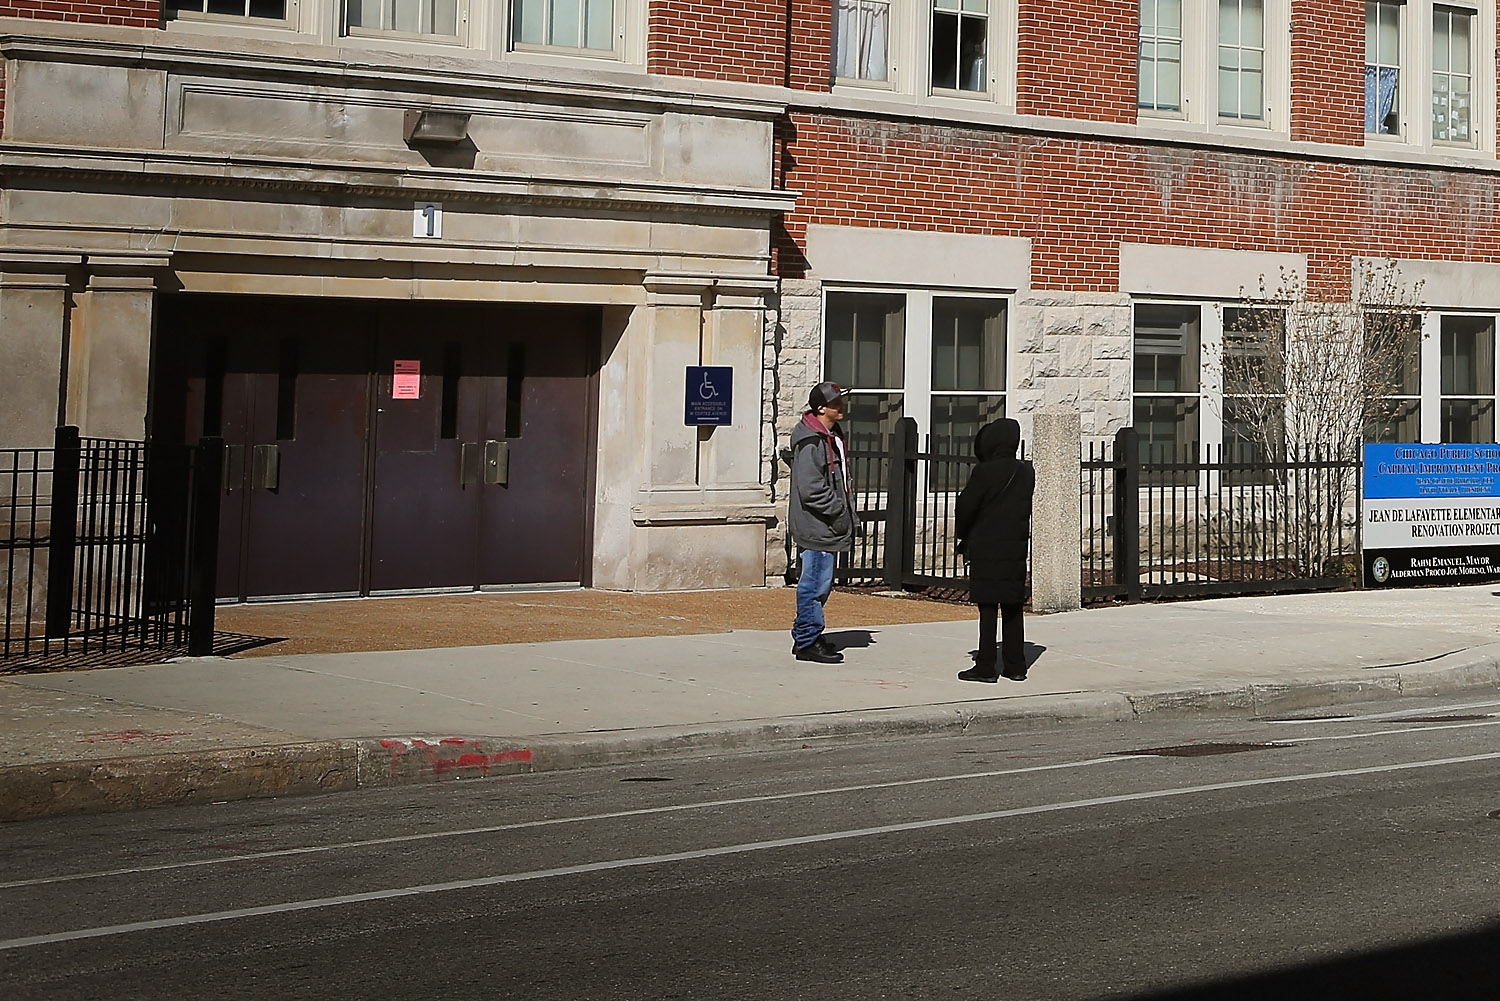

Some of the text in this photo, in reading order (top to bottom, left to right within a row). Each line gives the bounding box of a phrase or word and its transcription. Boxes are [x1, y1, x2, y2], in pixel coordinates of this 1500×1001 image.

[422, 206, 435, 237] 1
[1395, 448, 1437, 460] CHICAGO
[1440, 447, 1472, 459] PUBLIC
[1378, 463, 1418, 474] CAPITAL
[1419, 462, 1485, 474] IMPROVEMENT
[1369, 509, 1390, 522] JEAN
[1392, 509, 1403, 522] DE
[1405, 508, 1451, 521] LAFAYETTE
[1411, 523, 1500, 537] RENOVATION PROJECT
[1411, 558, 1431, 567] RAHM
[1466, 556, 1490, 565] MAYOR
[1390, 570, 1424, 578] ALDERMAN
[1425, 568, 1446, 576] PROCO
[1447, 567, 1458, 575] JOE
